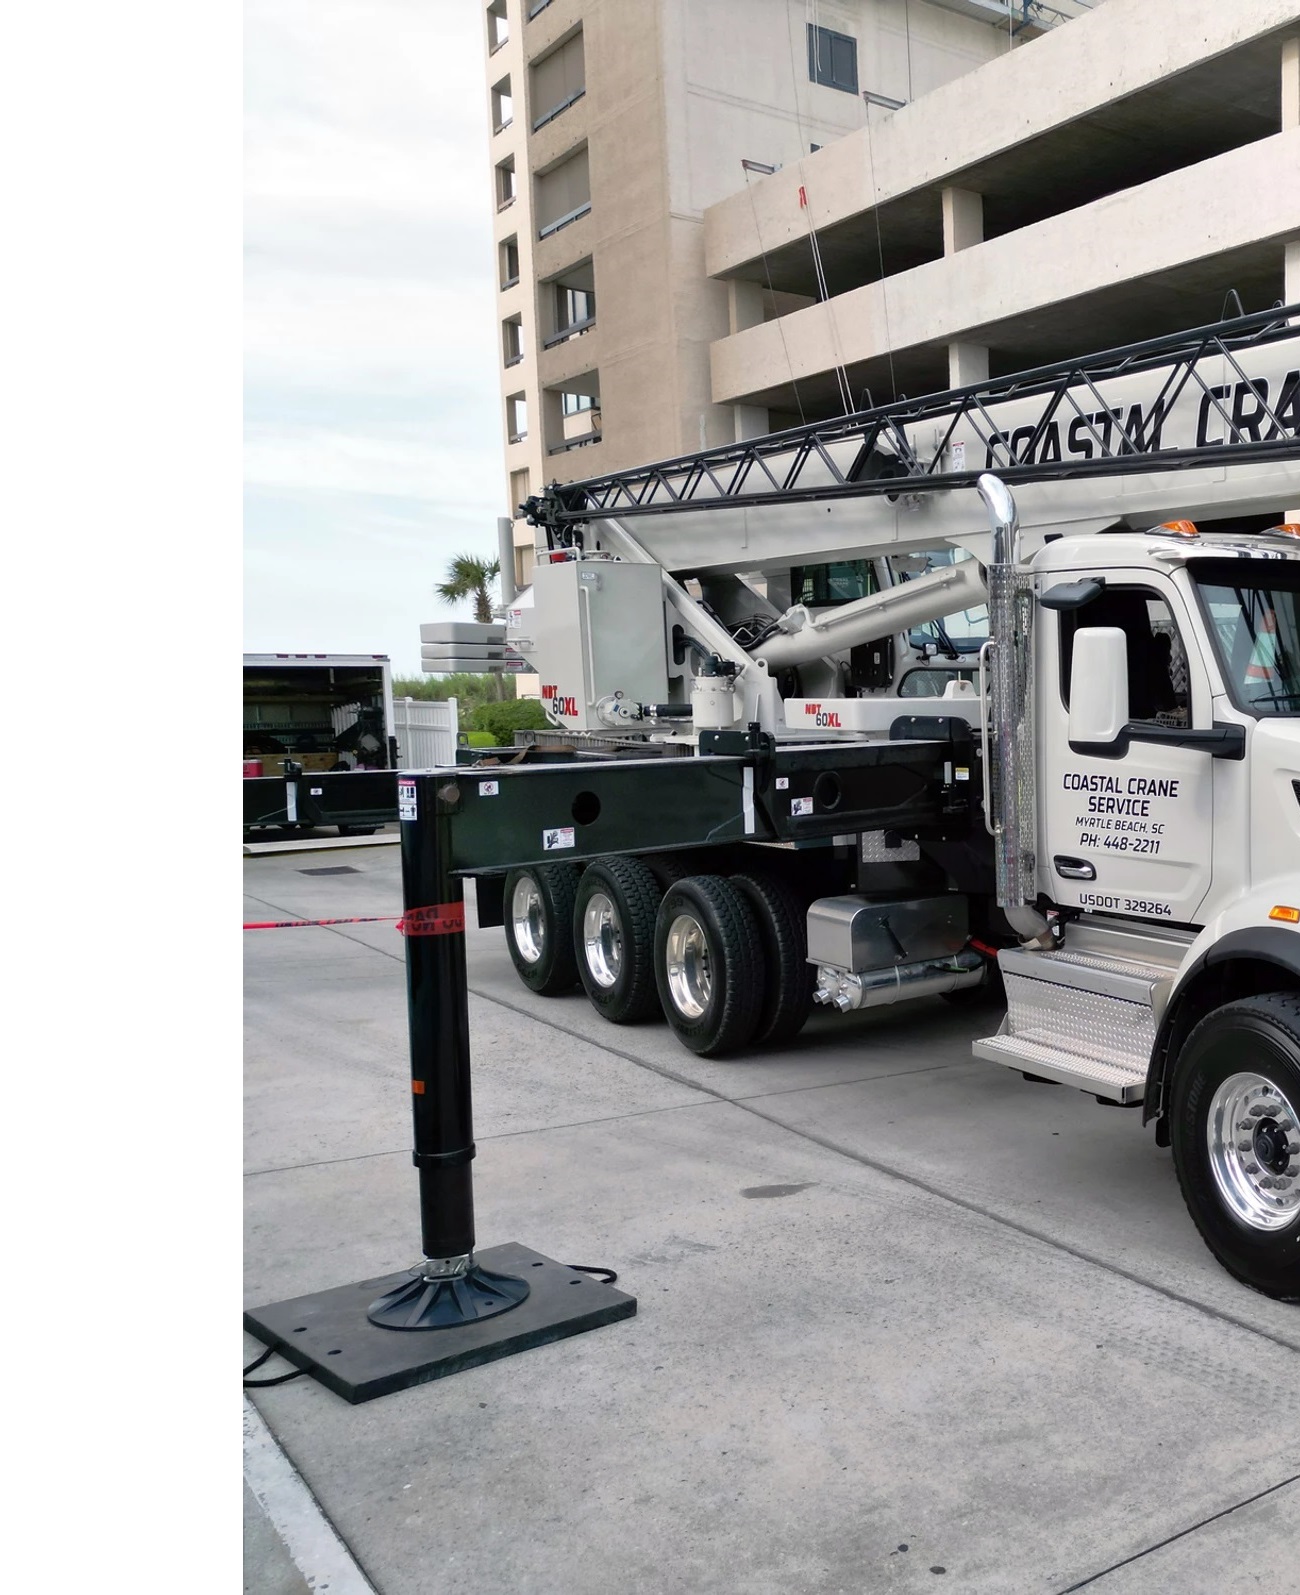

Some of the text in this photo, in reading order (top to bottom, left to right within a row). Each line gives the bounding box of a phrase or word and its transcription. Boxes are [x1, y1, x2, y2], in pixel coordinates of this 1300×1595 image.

[985, 396, 1178, 469] COASTAL
[552, 696, 579, 716] 60XL
[816, 712, 842, 728] 60XL
[1063, 773, 1180, 797] COASTAL CRANE
[1088, 796, 1150, 817] SERVICE
[1075, 816, 1113, 830] MYRTLE
[1151, 823, 1165, 835] SC
[1079, 832, 1161, 854] PH: 448-2211
[1079, 893, 1172, 916] USDOT 329264
